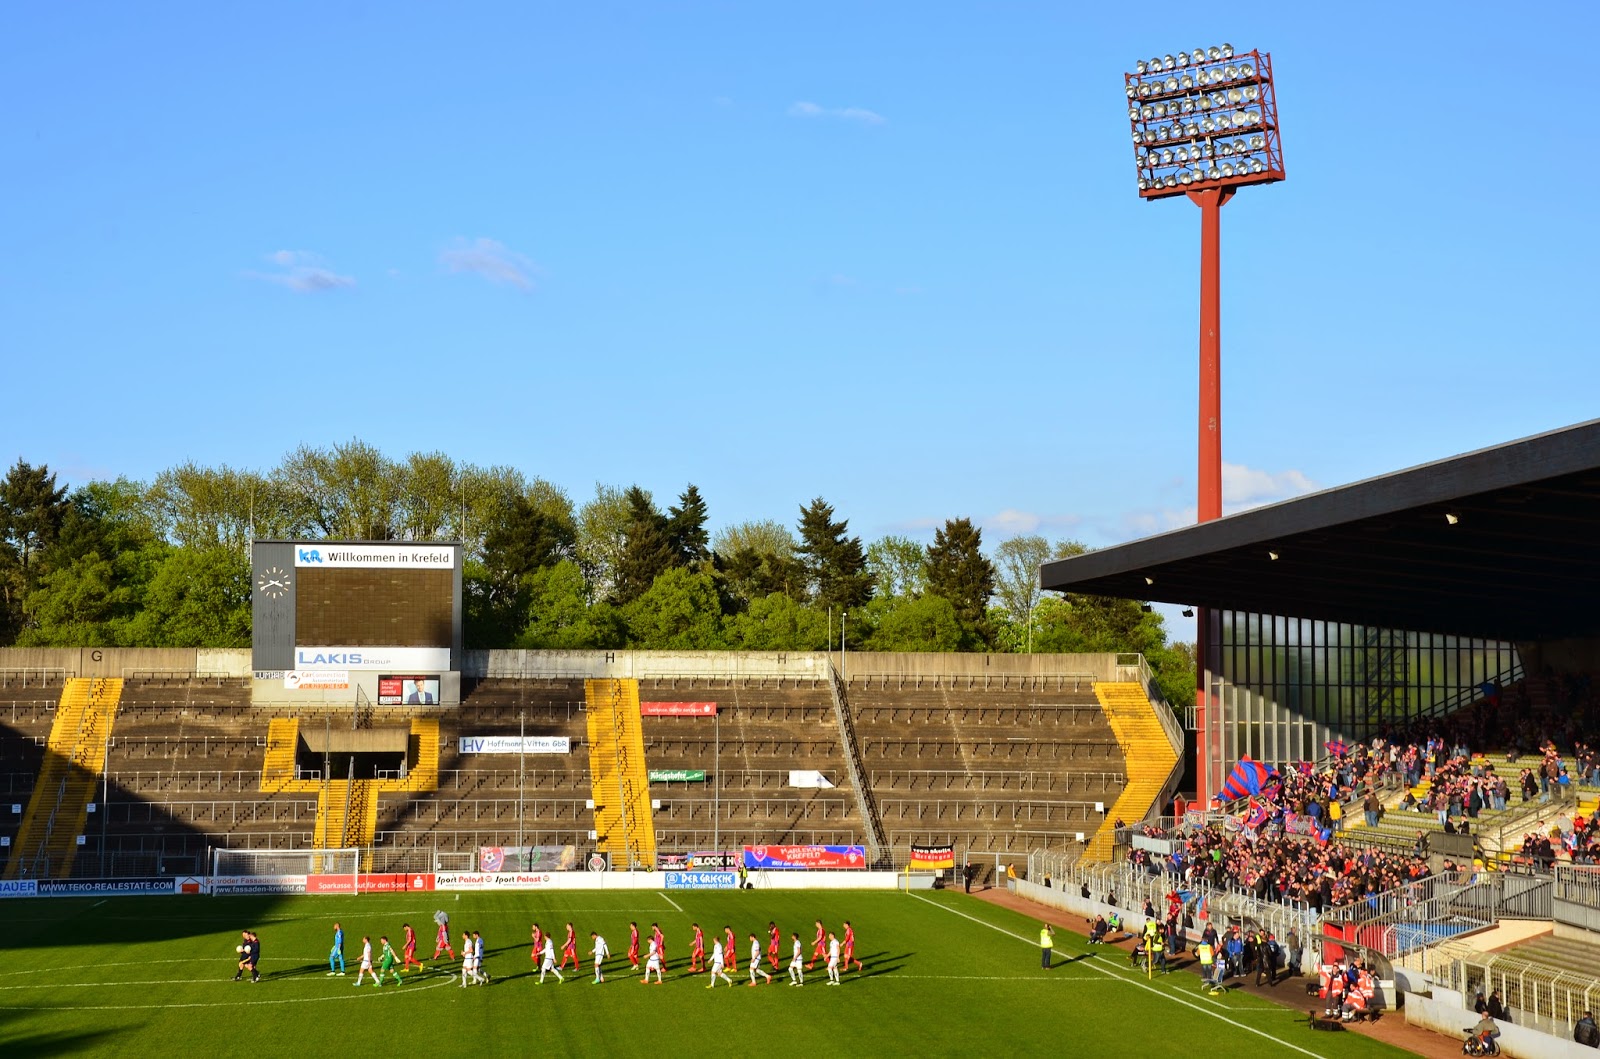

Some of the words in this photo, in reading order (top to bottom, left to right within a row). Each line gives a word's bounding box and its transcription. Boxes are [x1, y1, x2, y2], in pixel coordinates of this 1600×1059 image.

[328, 552, 395, 562] Willkommen
[399, 552, 408, 562] in
[411, 553, 449, 563] Krefeld
[91, 650, 102, 662] G
[299, 651, 362, 664] LAKIS
[605, 652, 615, 663] H
[777, 654, 787, 664] H
[463, 739, 485, 752] HV
[787, 852, 821, 860] KREFELD
[693, 857, 724, 866] BLOCK
[726, 857, 734, 866] H
[459, 875, 484, 883] Palast
[40, 882, 173, 892] WWW.TEKO-REALESTATE.COM
[319, 881, 352, 890] Sparkasse.
[377, 881, 390, 889] den
